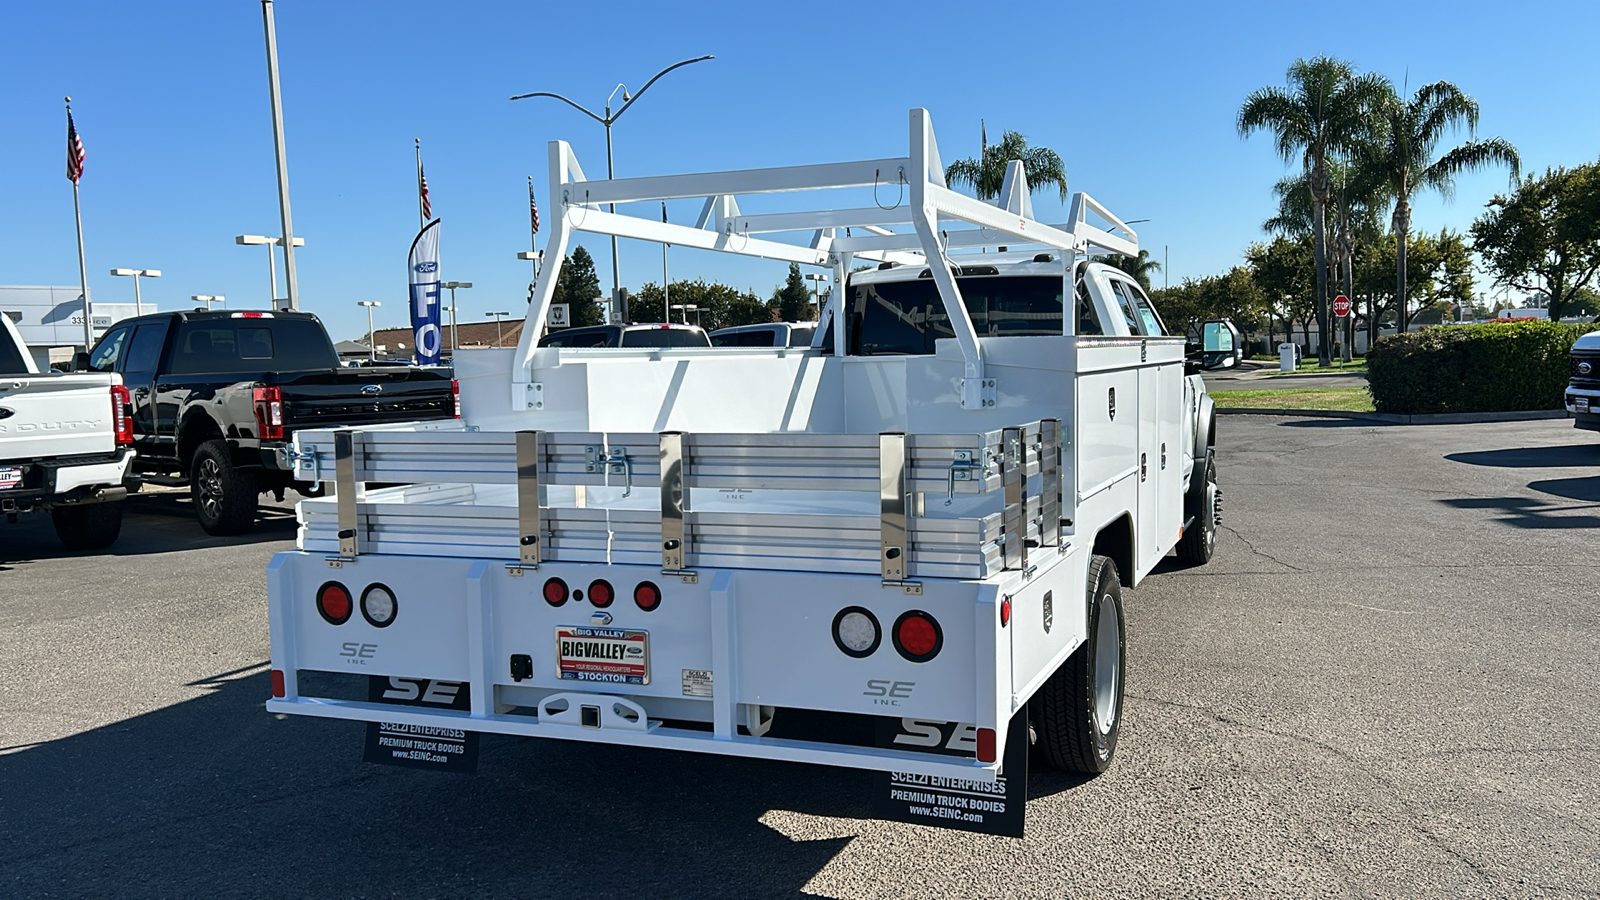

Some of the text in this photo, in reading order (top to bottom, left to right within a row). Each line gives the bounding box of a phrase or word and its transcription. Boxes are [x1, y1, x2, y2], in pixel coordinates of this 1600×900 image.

[1334, 302, 1349, 310] STOP
[16, 420, 101, 432] DUTY
[594, 630, 624, 638] VALLEY
[339, 642, 378, 658] SE
[562, 641, 627, 660] BIGVALLEY
[578, 672, 626, 682] STOCKTON
[382, 676, 462, 704] SE
[863, 679, 916, 698] SE
[410, 724, 465, 738] ENTERPRISES
[379, 737, 465, 754] PREMIUM TRUCK BODIES
[392, 750, 447, 763] www.SEINC.com
[931, 775, 1006, 794] ENTERPRISES
[891, 790, 1006, 813] PREMIUM TRUCK BODIES
[909, 805, 983, 823] www.SEINC.com
